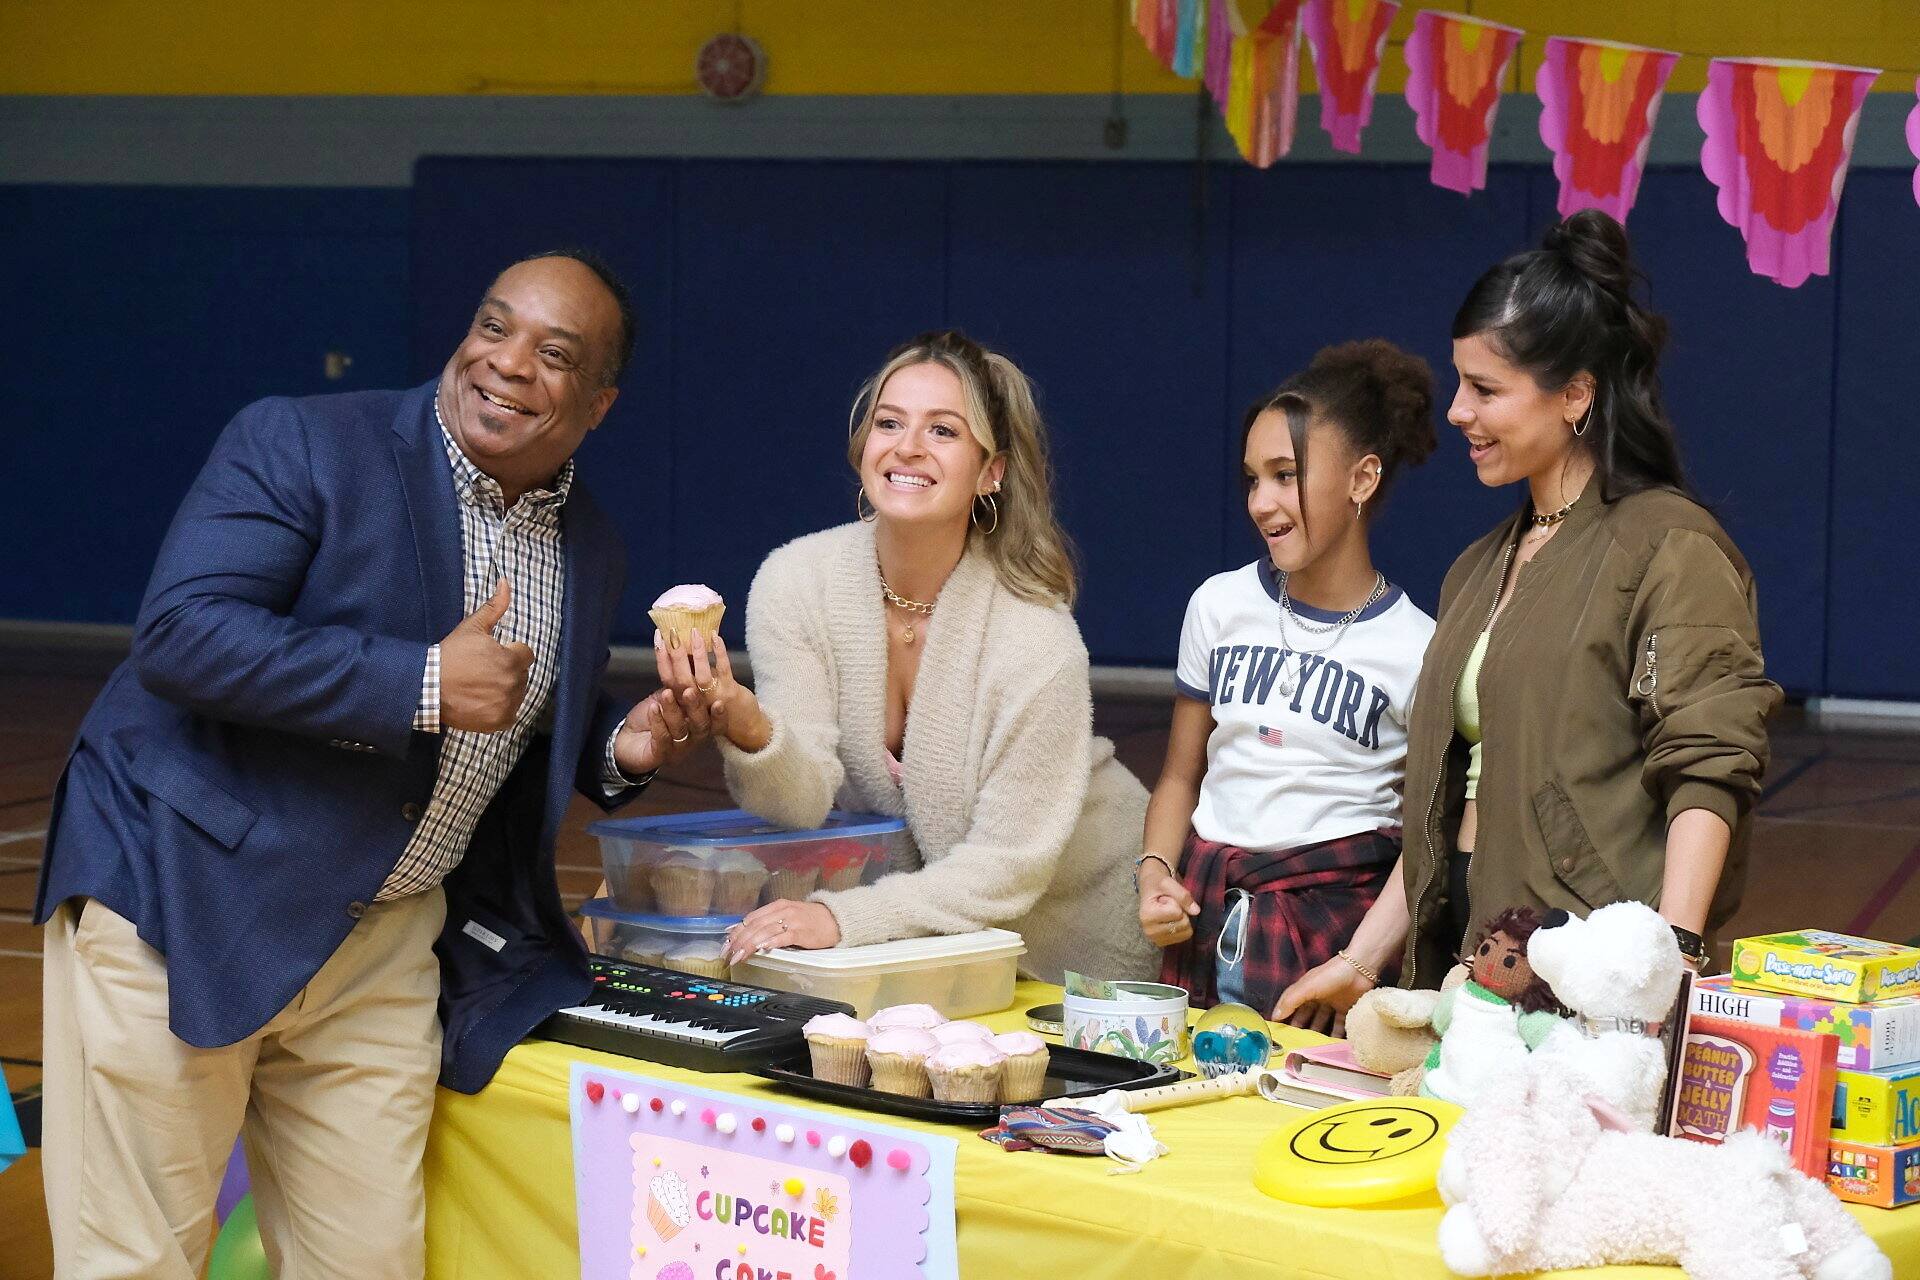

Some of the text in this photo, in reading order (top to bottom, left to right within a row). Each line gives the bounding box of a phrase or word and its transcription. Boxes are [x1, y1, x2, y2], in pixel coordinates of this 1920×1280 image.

[1209, 645, 1390, 750] NEW YORK
[1699, 993, 1751, 1018] HIGH
[1687, 1043, 1740, 1069] PEANUT
[1684, 1061, 1735, 1086] BUTTER
[1705, 1080, 1712, 1088] &
[1680, 1084, 1731, 1111] JELLY
[1677, 1104, 1727, 1131] MATH
[1831, 1164, 1877, 1182] AICS
[696, 1190, 825, 1248] CUPCAKE
